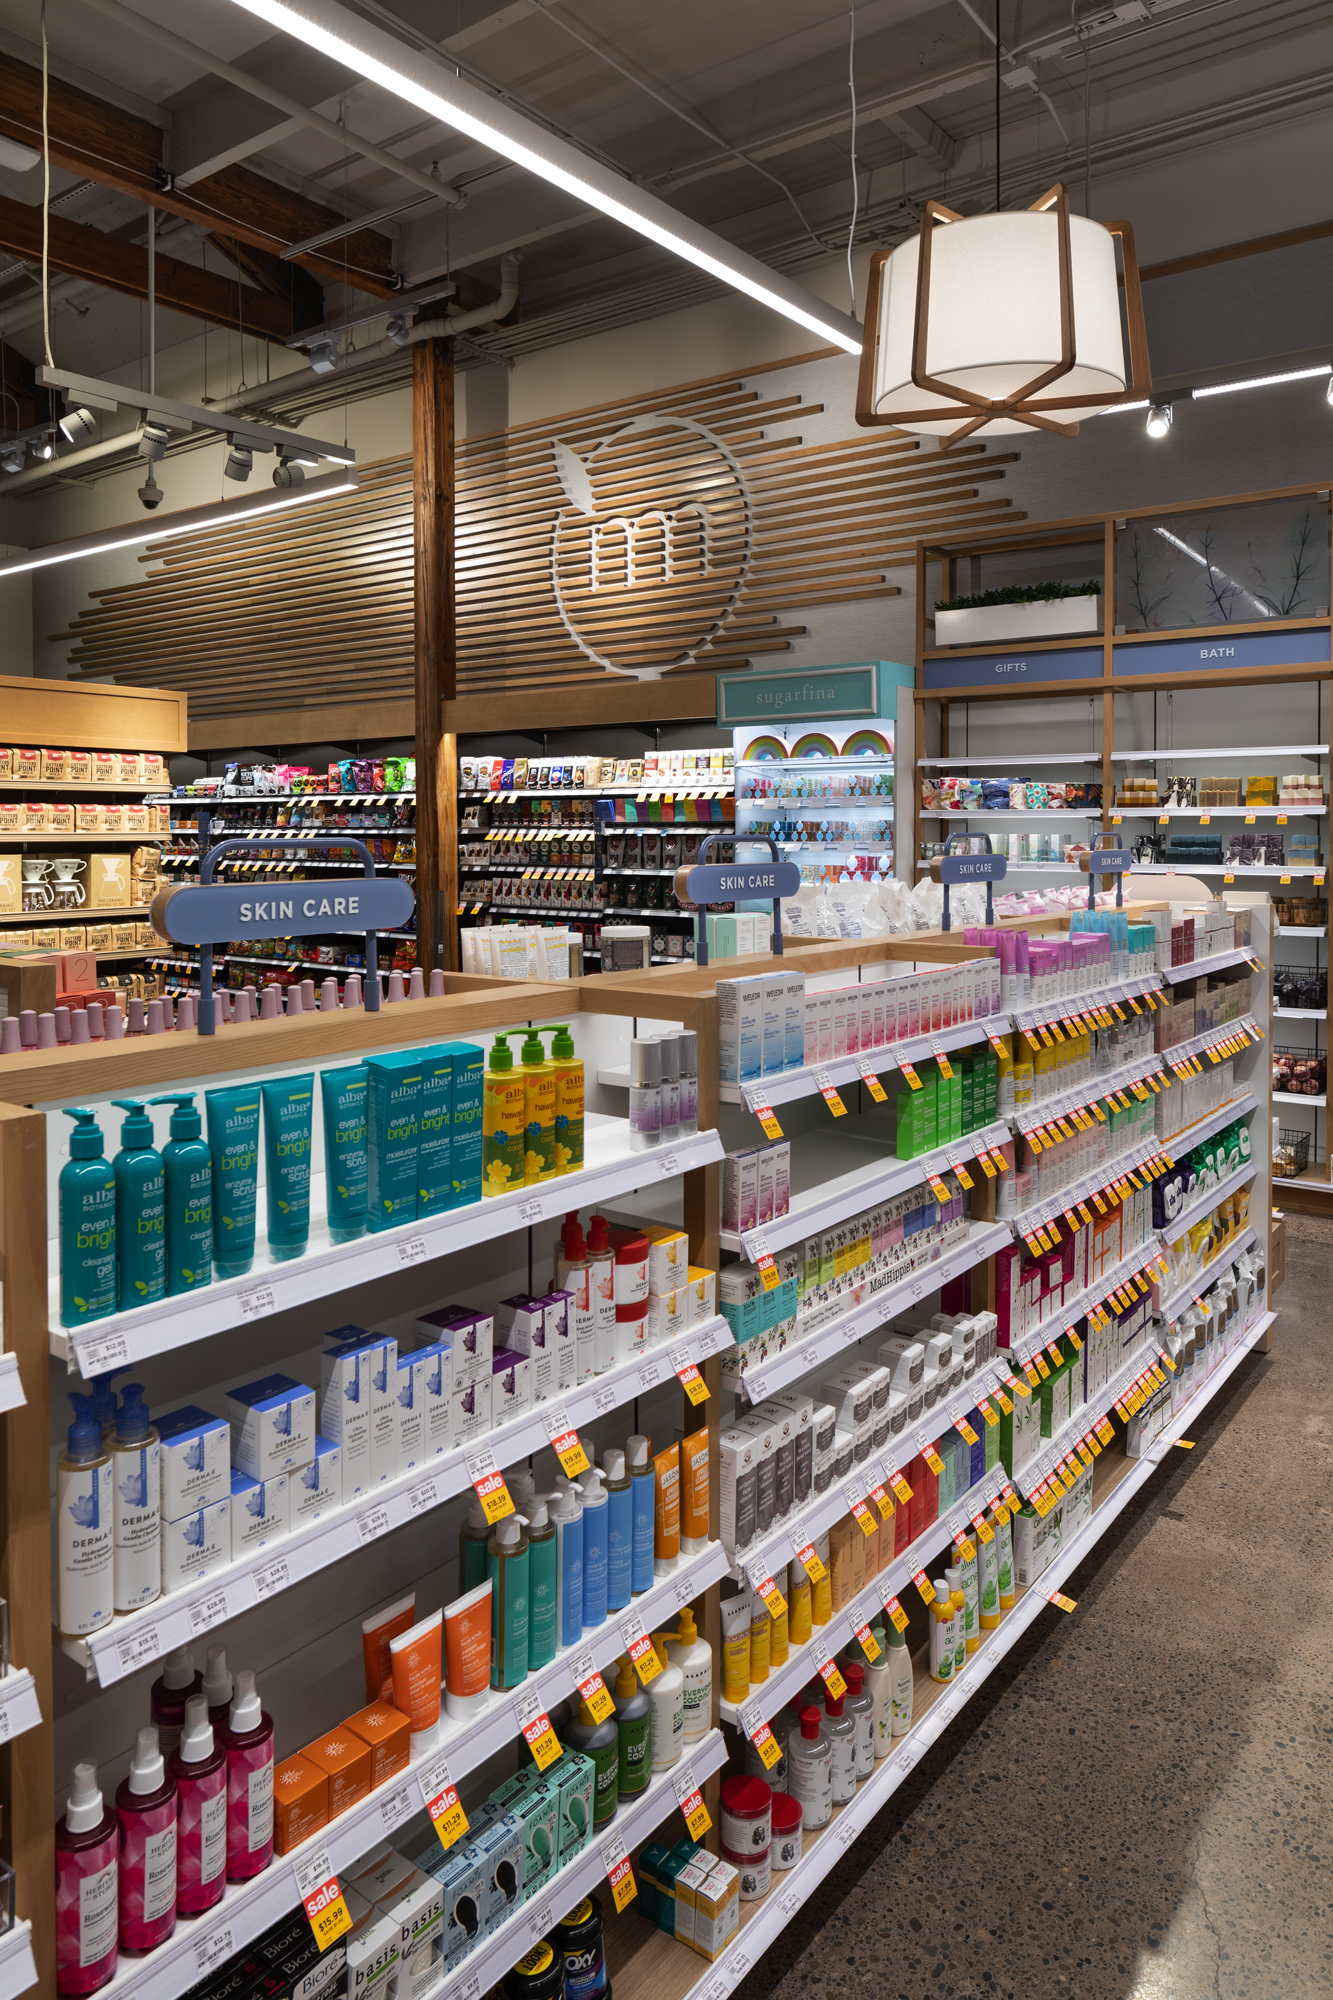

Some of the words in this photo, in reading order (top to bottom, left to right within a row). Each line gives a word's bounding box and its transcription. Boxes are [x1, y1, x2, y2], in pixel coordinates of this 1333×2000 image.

[1200, 647, 1235, 659] BATH
[995, 662, 1027, 673] GIFTS
[756, 683, 836, 708] sugarfina
[959, 864, 974, 875] SKIN
[975, 863, 992, 874] CARE
[1101, 857, 1111, 866] SKIN
[1112, 856, 1122, 865] CARE
[720, 876, 745, 890] SKIN
[748, 874, 775, 888] CARE
[239, 901, 294, 922] SKIN
[302, 897, 360, 918] CARE
[75, 958, 89, 982] 2
[742, 992, 761, 1002] WELEDA
[766, 988, 784, 998] WELEDA
[786, 984, 804, 994] WELEDA
[423, 1077, 446, 1090] alba
[457, 1071, 478, 1084] alba
[338, 1092, 362, 1104] alba
[390, 1084, 415, 1099] alba
[823, 1089, 838, 1100] sale
[280, 1103, 304, 1116] alba
[423, 1107, 441, 1118] even
[441, 1104, 448, 1113] &
[457, 1100, 474, 1111] even
[474, 1098, 480, 1107] &
[225, 1115, 251, 1128] alba
[338, 1118, 359, 1129] even
[360, 1115, 366, 1125] &
[390, 1116, 409, 1127] even
[409, 1113, 416, 1122] &
[421, 1113, 450, 1131] bright
[454, 1106, 482, 1124] bright
[758, 1109, 774, 1121] sale
[280, 1131, 302, 1142] even
[303, 1127, 309, 1137] &
[335, 1125, 368, 1143] bright
[387, 1123, 419, 1140] bright
[453, 1130, 482, 1143] moisturizer
[225, 1143, 248, 1155] even
[249, 1140, 255, 1150] &
[276, 1138, 311, 1156] bright
[420, 1137, 450, 1150] moisturizer
[221, 1151, 258, 1171] bright
[339, 1150, 365, 1161] enzyme
[386, 1146, 418, 1160] moisturizer
[280, 1163, 307, 1175] enzyme
[225, 1177, 252, 1189] enzyme
[189, 1195, 211, 1208] even
[141, 1204, 164, 1218] even
[81, 1218, 110, 1232] even
[96, 1261, 113, 1278] gel
[758, 1257, 774, 1270] sale
[869, 1260, 912, 1294] MadHippie
[256, 1291, 273, 1301] $12.99
[105, 1339, 126, 1352] $12.99
[679, 1367, 699, 1384] sale
[554, 1434, 578, 1454] sale
[563, 1451, 582, 1466] $19.99
[477, 1476, 503, 1497] sale
[486, 1494, 506, 1510] $18.39
[873, 1488, 886, 1502] sale
[853, 1503, 868, 1519] sale
[799, 1547, 815, 1564] sale
[914, 1572, 927, 1588] sale
[758, 1581, 776, 1599] sale
[886, 1599, 899, 1615] sale
[138, 1632, 159, 1648] $15.99
[858, 1627, 871, 1643] sale
[631, 1639, 651, 1661] sale
[639, 1656, 655, 1672] $11.29
[821, 1662, 837, 1682] sale
[581, 1676, 603, 1699] sale
[592, 1694, 607, 1711] $11.29
[526, 1717, 550, 1743] sale
[754, 1727, 772, 1749] sale
[535, 1738, 553, 1755] $11.29
[565, 1773, 591, 1799] FOAMIE
[430, 1791, 457, 1819] sale
[683, 1794, 702, 1818] sale
[442, 1812, 461, 1832] $11.29
[528, 1801, 554, 1830] FOAMIE
[493, 1833, 521, 1865] FOAMIE
[610, 1862, 630, 1886] sale
[452, 1867, 483, 1900] FOAMIE
[617, 1880, 632, 1898] $7.99
[306, 1883, 339, 1917] sale
[318, 1907, 344, 1932] $15.99
[263, 1927, 303, 1959] Bioré
[565, 1948, 596, 1971] OXY
[302, 1953, 338, 1995] Bioré
[263, 1977, 277, 1989] 6
